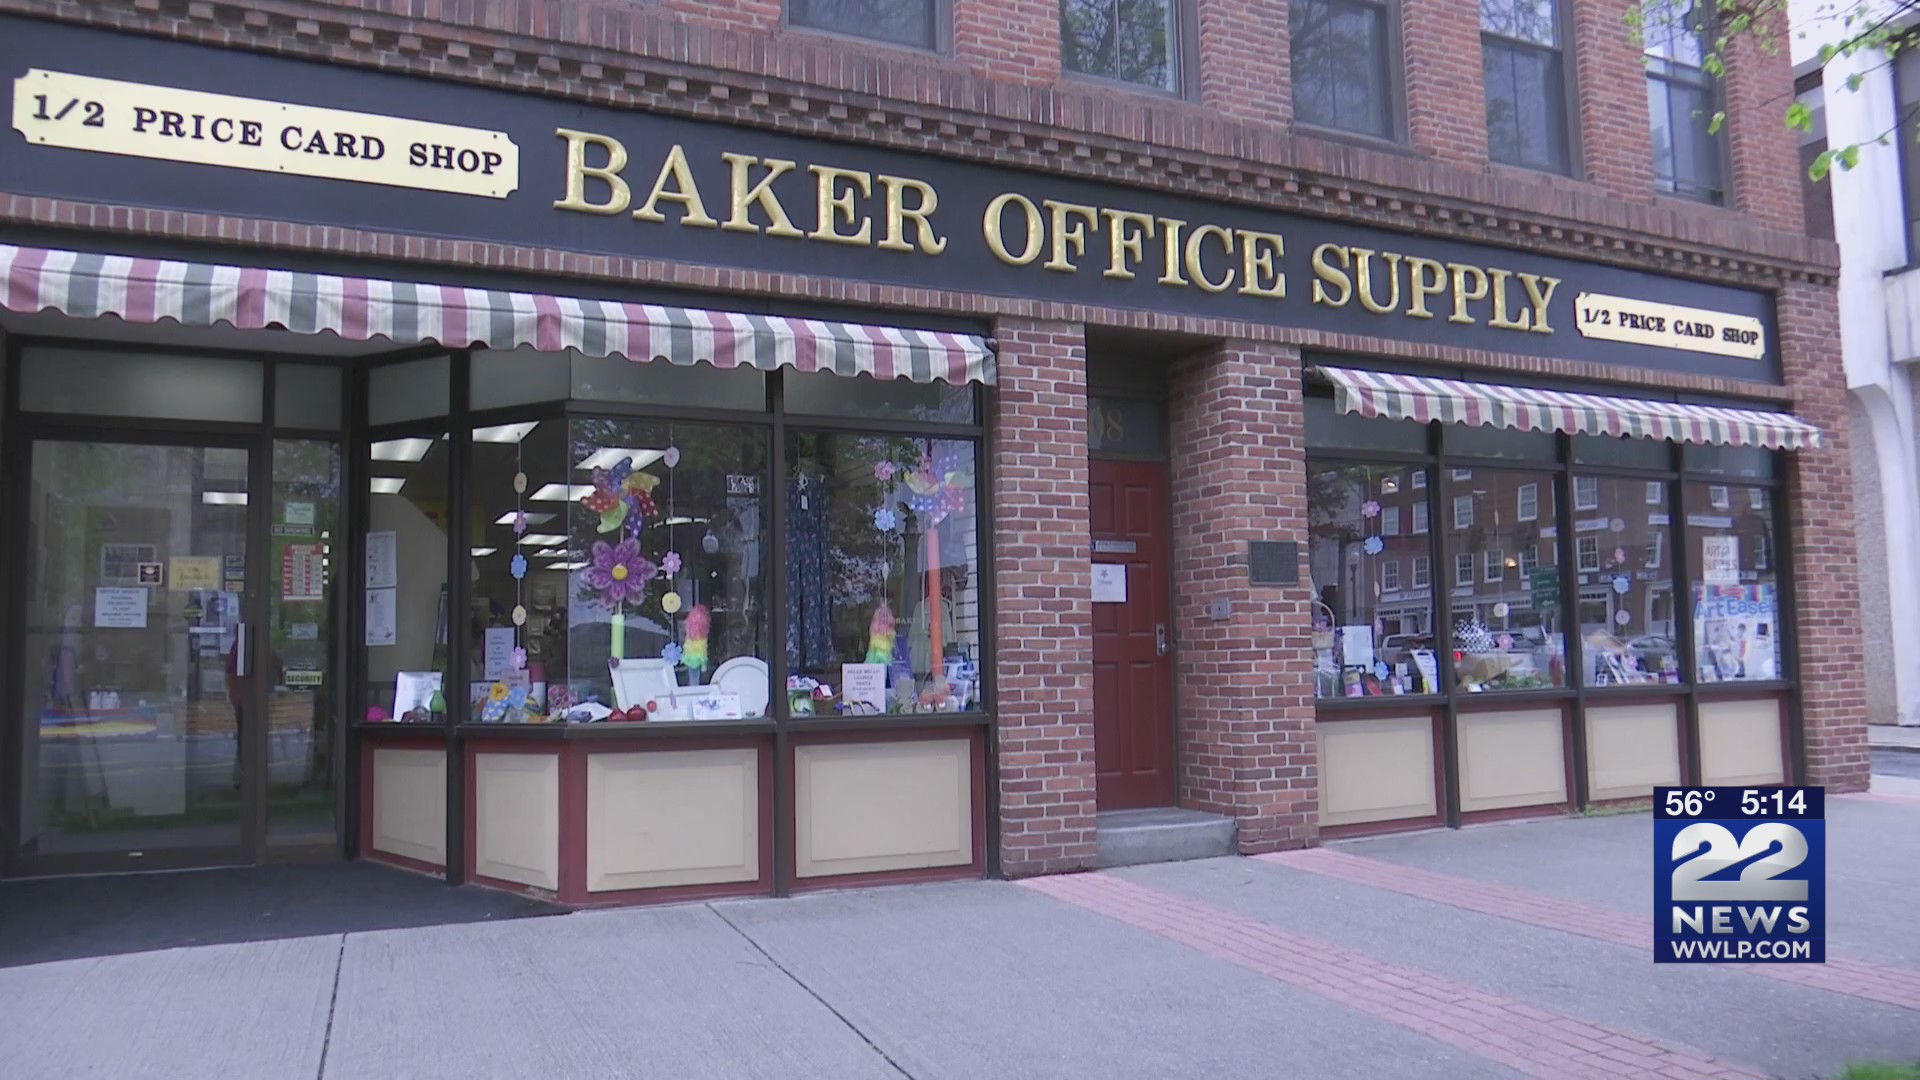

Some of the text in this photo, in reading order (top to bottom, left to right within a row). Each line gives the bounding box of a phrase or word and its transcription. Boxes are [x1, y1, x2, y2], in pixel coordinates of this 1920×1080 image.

[32, 94, 503, 176] 1/2 PRICE CARD SHOP
[553, 127, 1561, 334] BAKER OFFICE SUPPLY
[1583, 308, 1759, 346] 1/2 PRICE CARD SHOP
